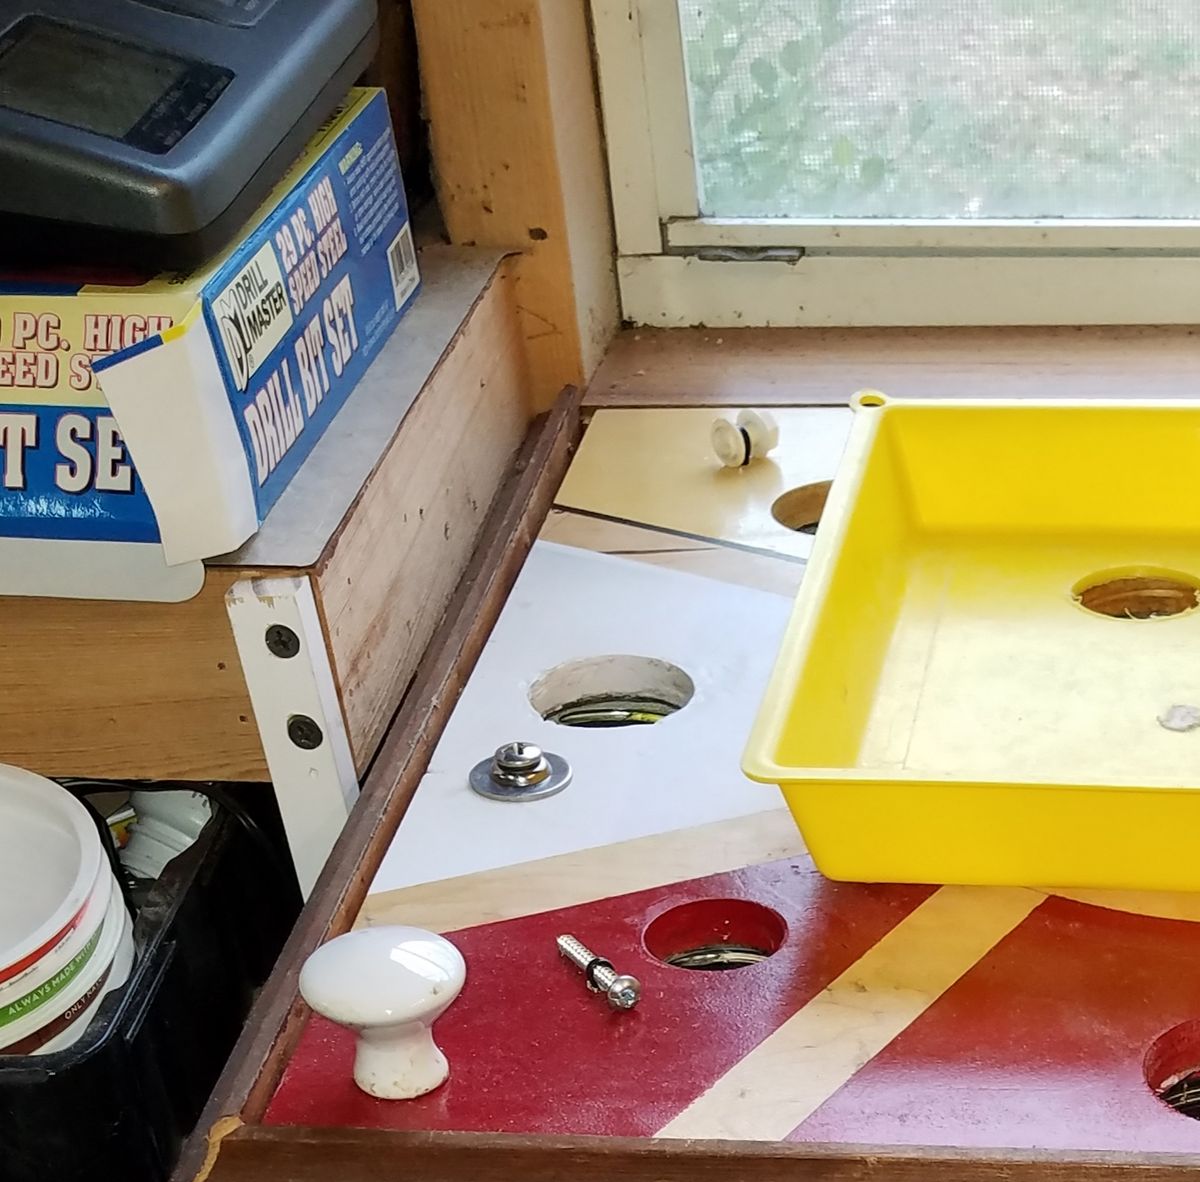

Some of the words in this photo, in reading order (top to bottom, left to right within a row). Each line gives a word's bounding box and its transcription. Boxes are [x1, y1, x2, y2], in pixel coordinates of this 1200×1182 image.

[275, 224, 297, 273] 29
[292, 199, 315, 251] PC.
[308, 175, 338, 233] HIGH
[235, 260, 269, 310] DRILL
[288, 250, 320, 316] SPEED
[318, 217, 348, 279] STEEL
[13, 312, 70, 352] PC.
[246, 281, 287, 343] MASTER
[244, 356, 305, 488] DRILL
[294, 313, 331, 418] BIT
[323, 272, 359, 378] SET
[56, 413, 135, 493] SE
[7, 982, 51, 1016] ALWAYS
[51, 963, 76, 988] MADE
[64, 997, 86, 1021] ONLY
